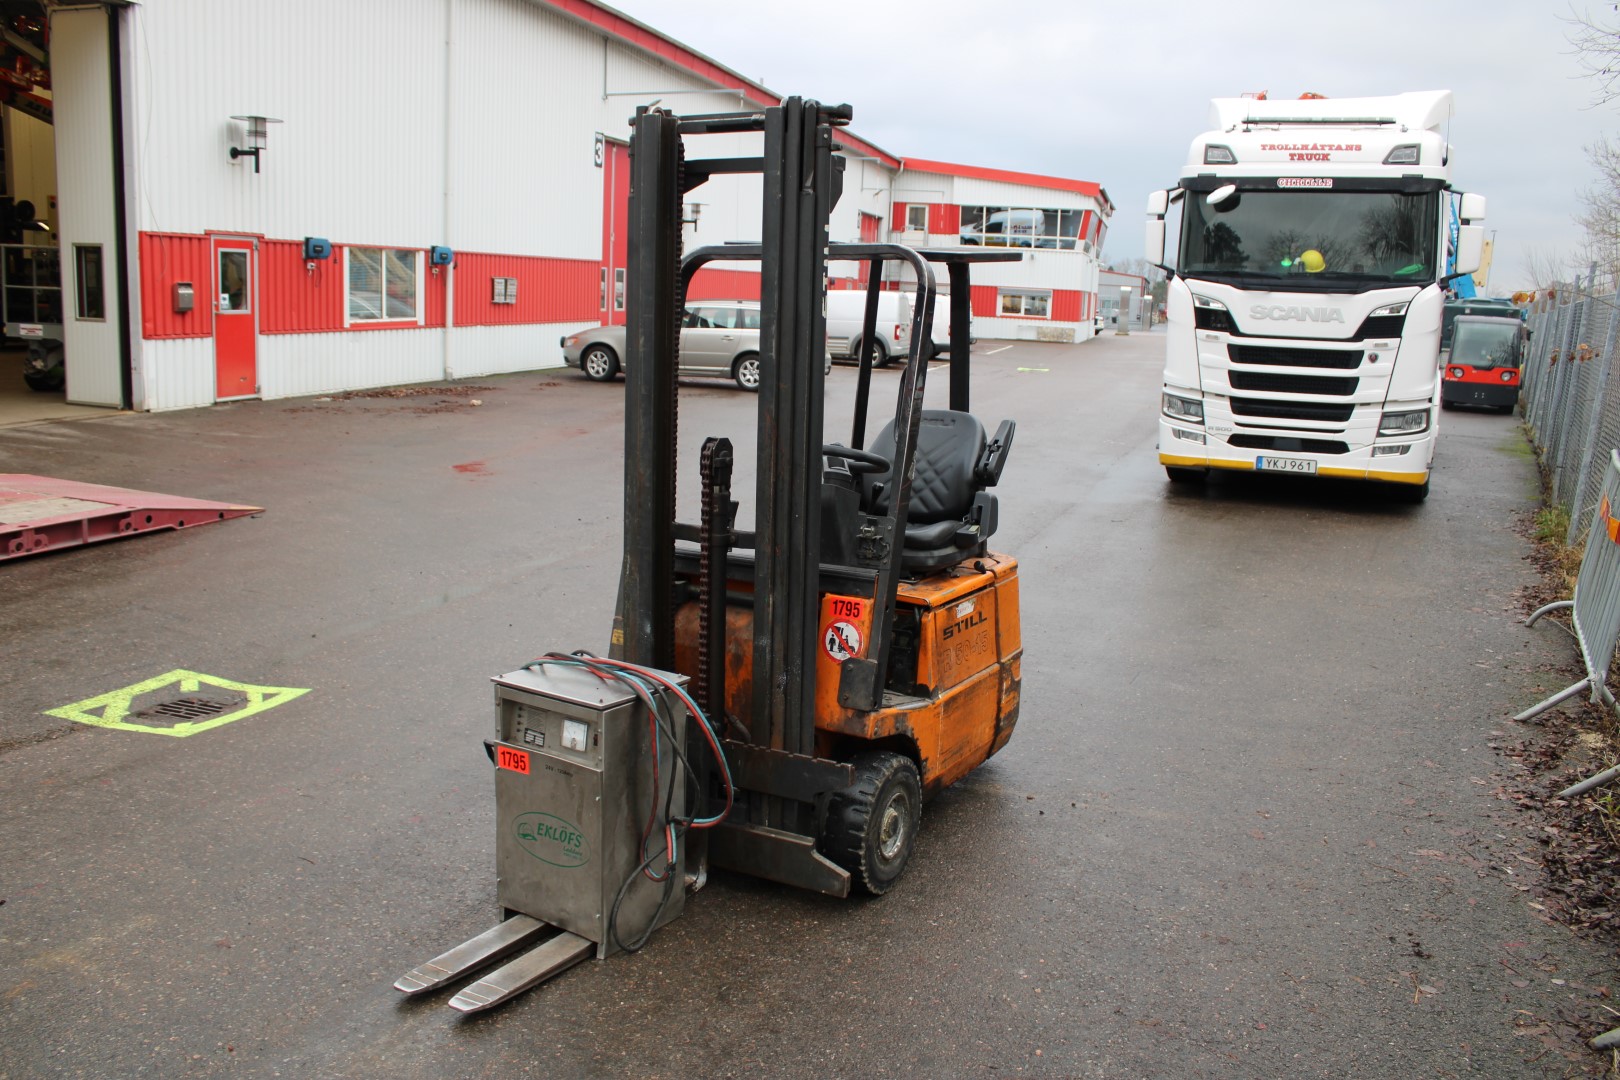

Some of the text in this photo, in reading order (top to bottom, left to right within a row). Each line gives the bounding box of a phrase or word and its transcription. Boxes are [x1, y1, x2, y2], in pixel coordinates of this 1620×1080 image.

[595, 142, 603, 164] 3
[1288, 153, 1331, 161] TRUCK
[1249, 304, 1345, 323] SCANIA
[1266, 459, 1311, 472] YKJ 961
[833, 600, 860, 618] 1795
[943, 611, 987, 640] STILL
[500, 750, 526, 771] 1795
[537, 823, 582, 848] EKLÖFS
